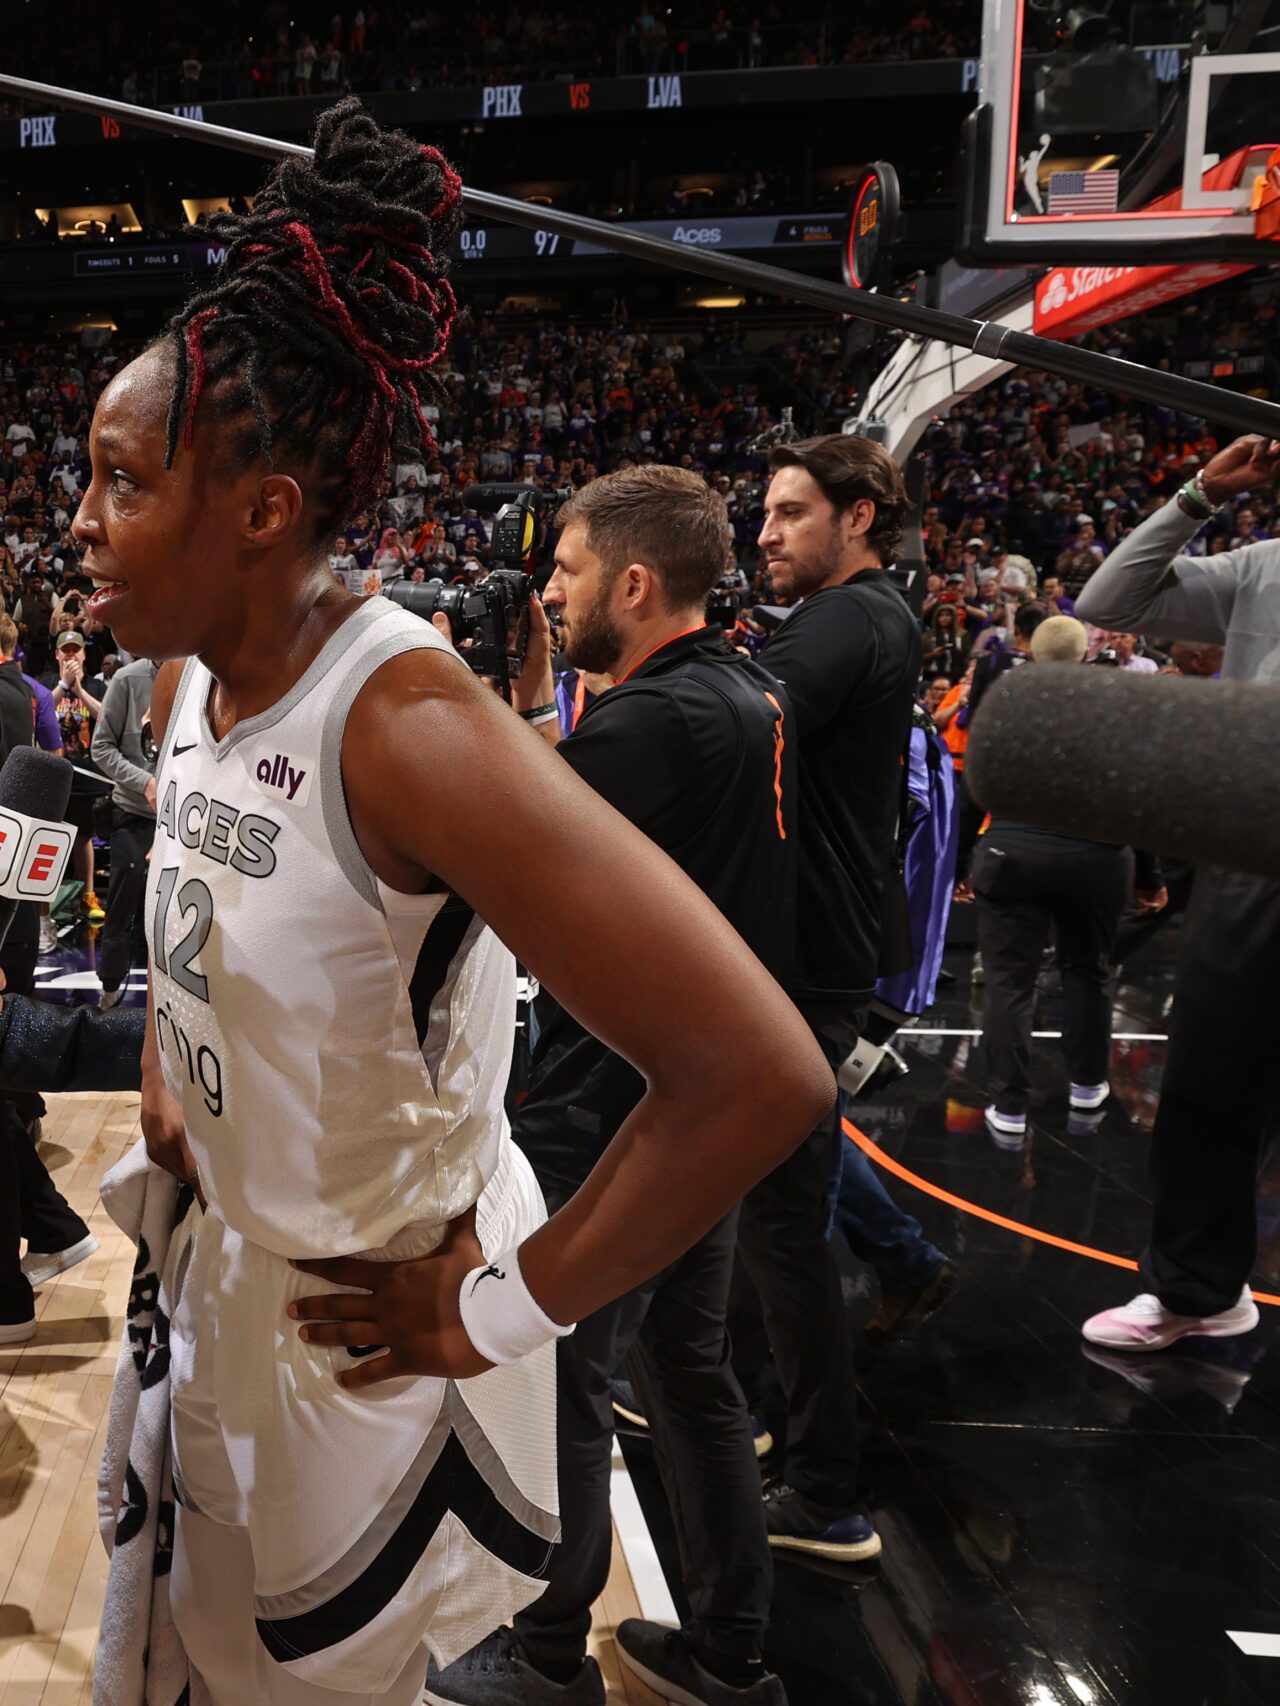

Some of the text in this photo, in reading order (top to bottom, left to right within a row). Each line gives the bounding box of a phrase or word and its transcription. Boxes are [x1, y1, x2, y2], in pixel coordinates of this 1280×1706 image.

[483, 75, 682, 118] PHX VS LVA
[20, 116, 120, 148] PHX VS
[460, 230, 486, 250] 0.0
[534, 230, 560, 256] 97
[672, 226, 722, 244] Aces
[87, 258, 121, 267] TIMEOUTS
[143, 254, 180, 264] FOULS 5
[256, 754, 306, 800] ally
[157, 780, 281, 878] ACES
[154, 866, 213, 1004] 12
[157, 1001, 223, 1117] ring
